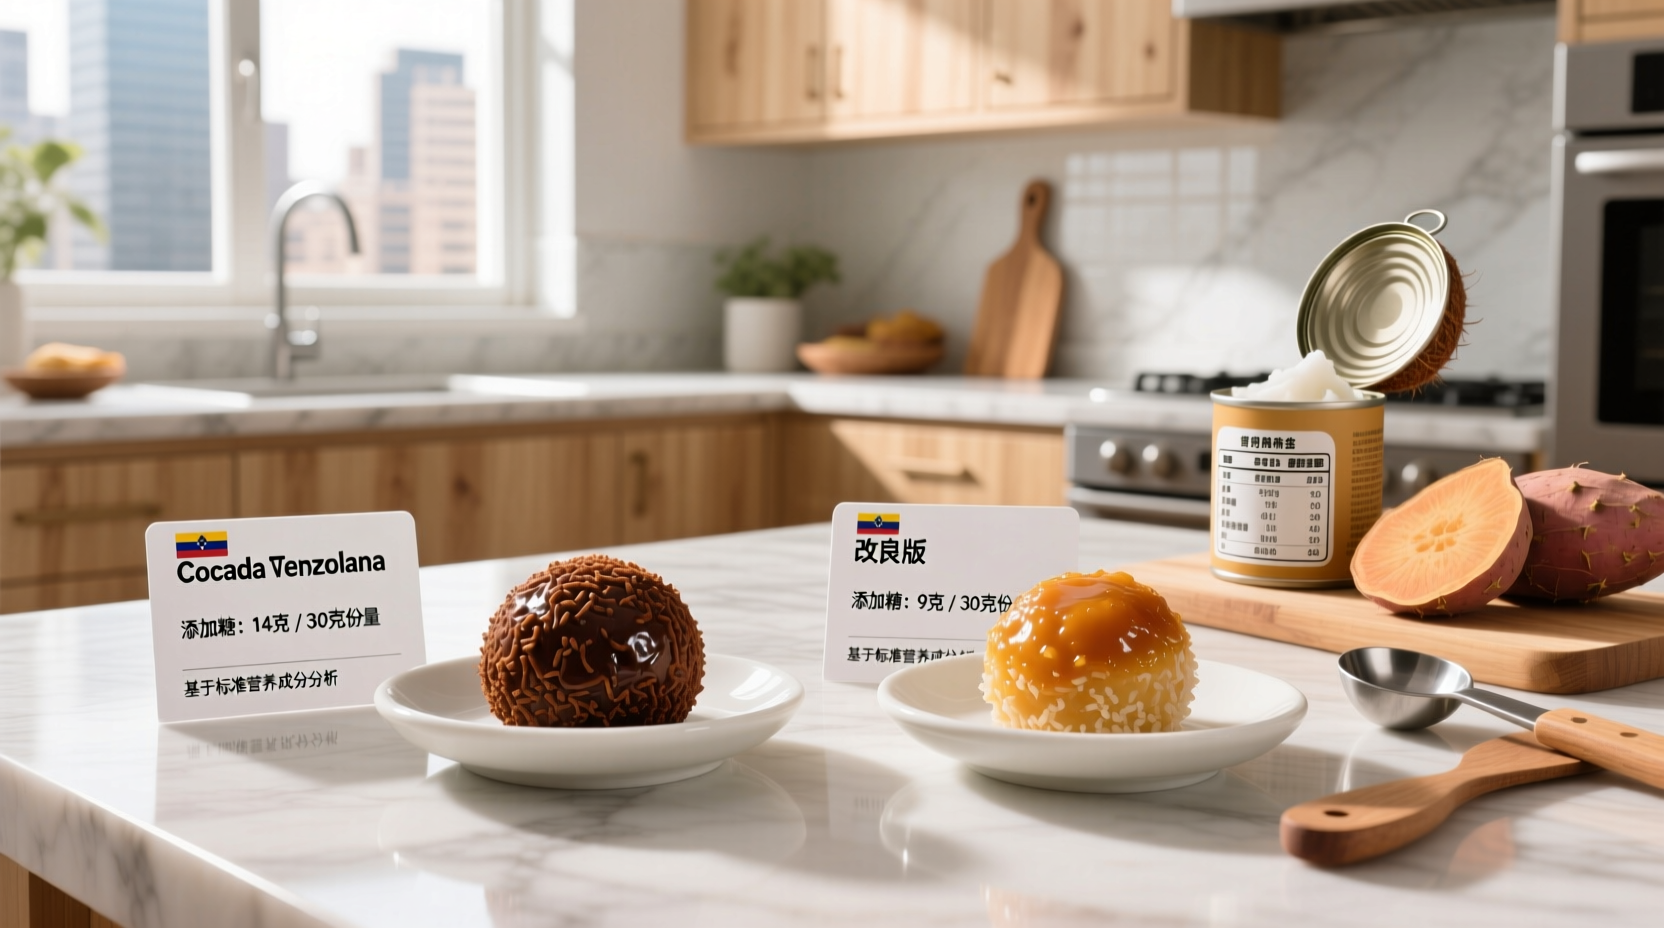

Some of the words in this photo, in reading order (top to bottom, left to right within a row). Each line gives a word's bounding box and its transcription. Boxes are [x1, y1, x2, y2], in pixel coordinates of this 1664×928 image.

[854, 538, 927, 564] 改良版
[177, 556, 266, 583] Cocada
[269, 551, 386, 578] Venzolana
[306, 606, 381, 629] 30克份量
[184, 669, 338, 698] 基于标准营养成分分析
